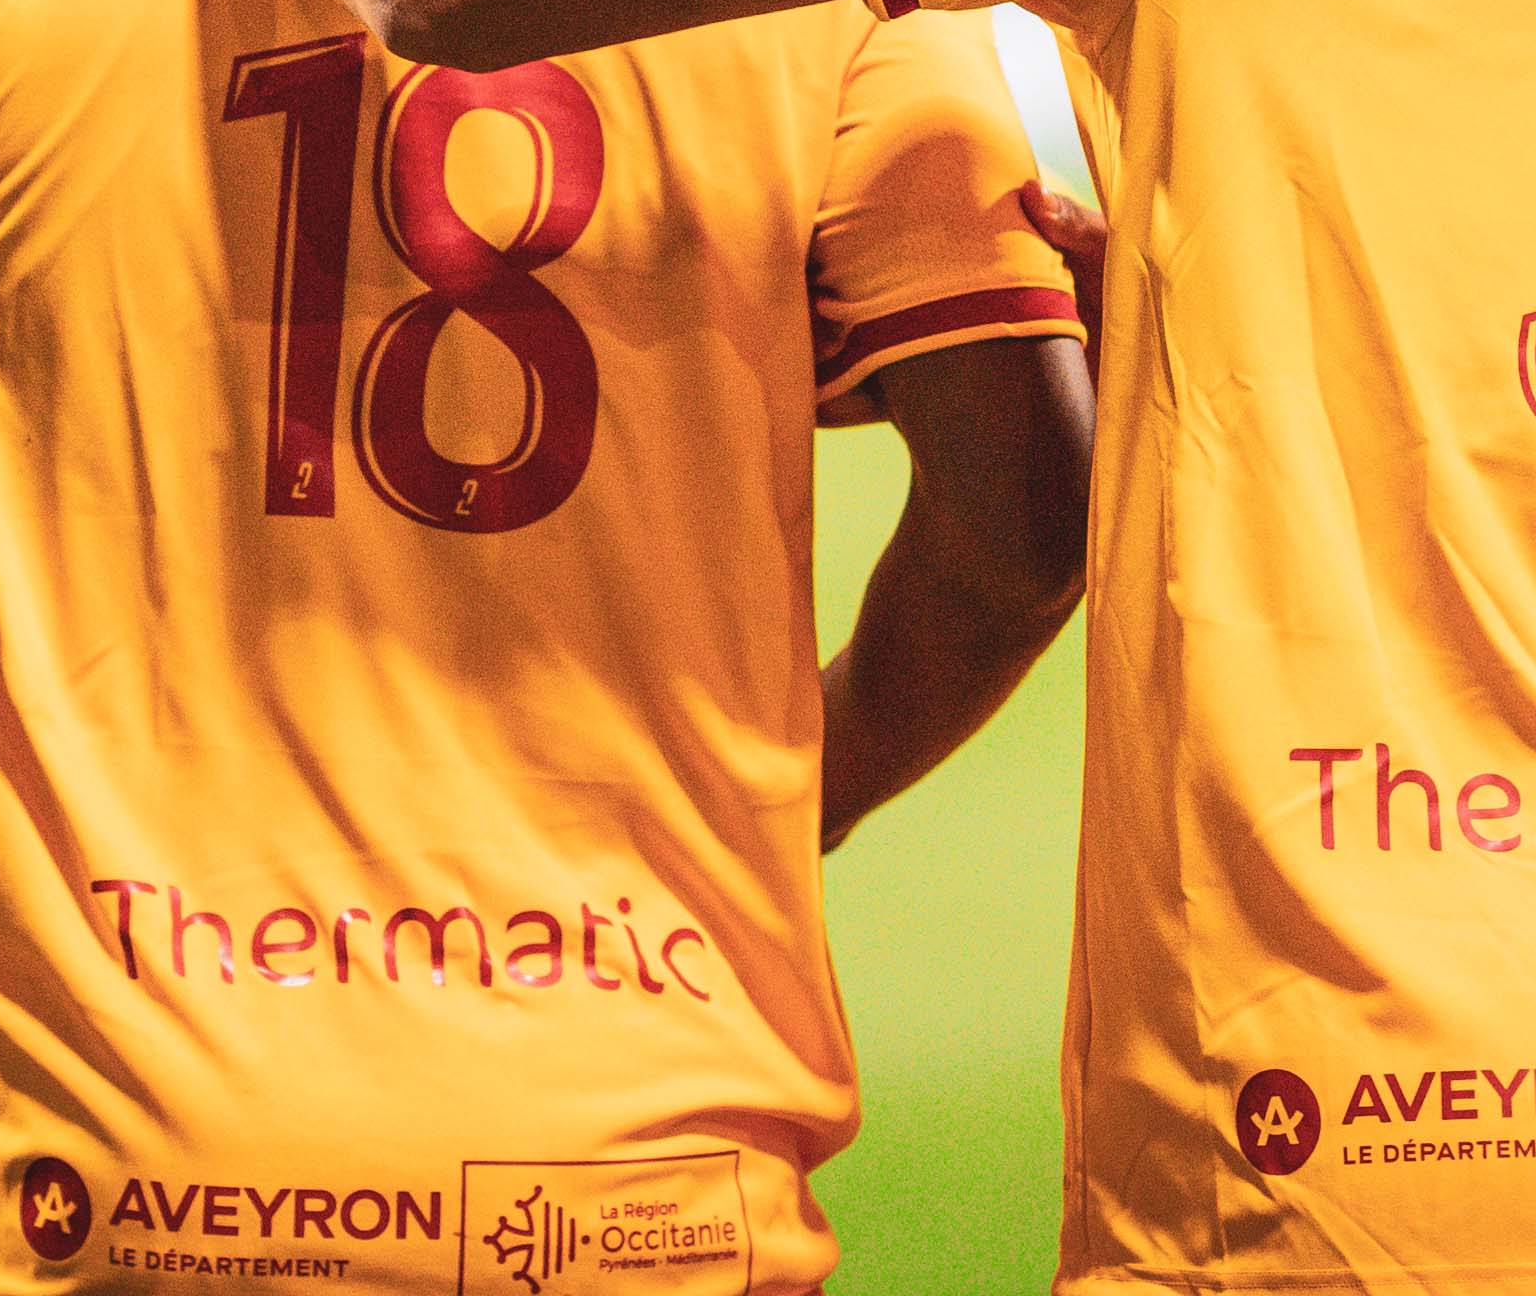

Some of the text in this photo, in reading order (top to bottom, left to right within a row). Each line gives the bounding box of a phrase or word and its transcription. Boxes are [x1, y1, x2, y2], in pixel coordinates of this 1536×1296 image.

[222, 30, 605, 535] 18
[91, 877, 711, 1001] Thermatic
[1343, 1145, 1373, 1165] LE
[109, 1177, 441, 1240] AVEYRON
[600, 1200, 678, 1221] La Région
[600, 1215, 737, 1253] Occitanie
[108, 1245, 350, 1278] LE DÉPARTEMENT
